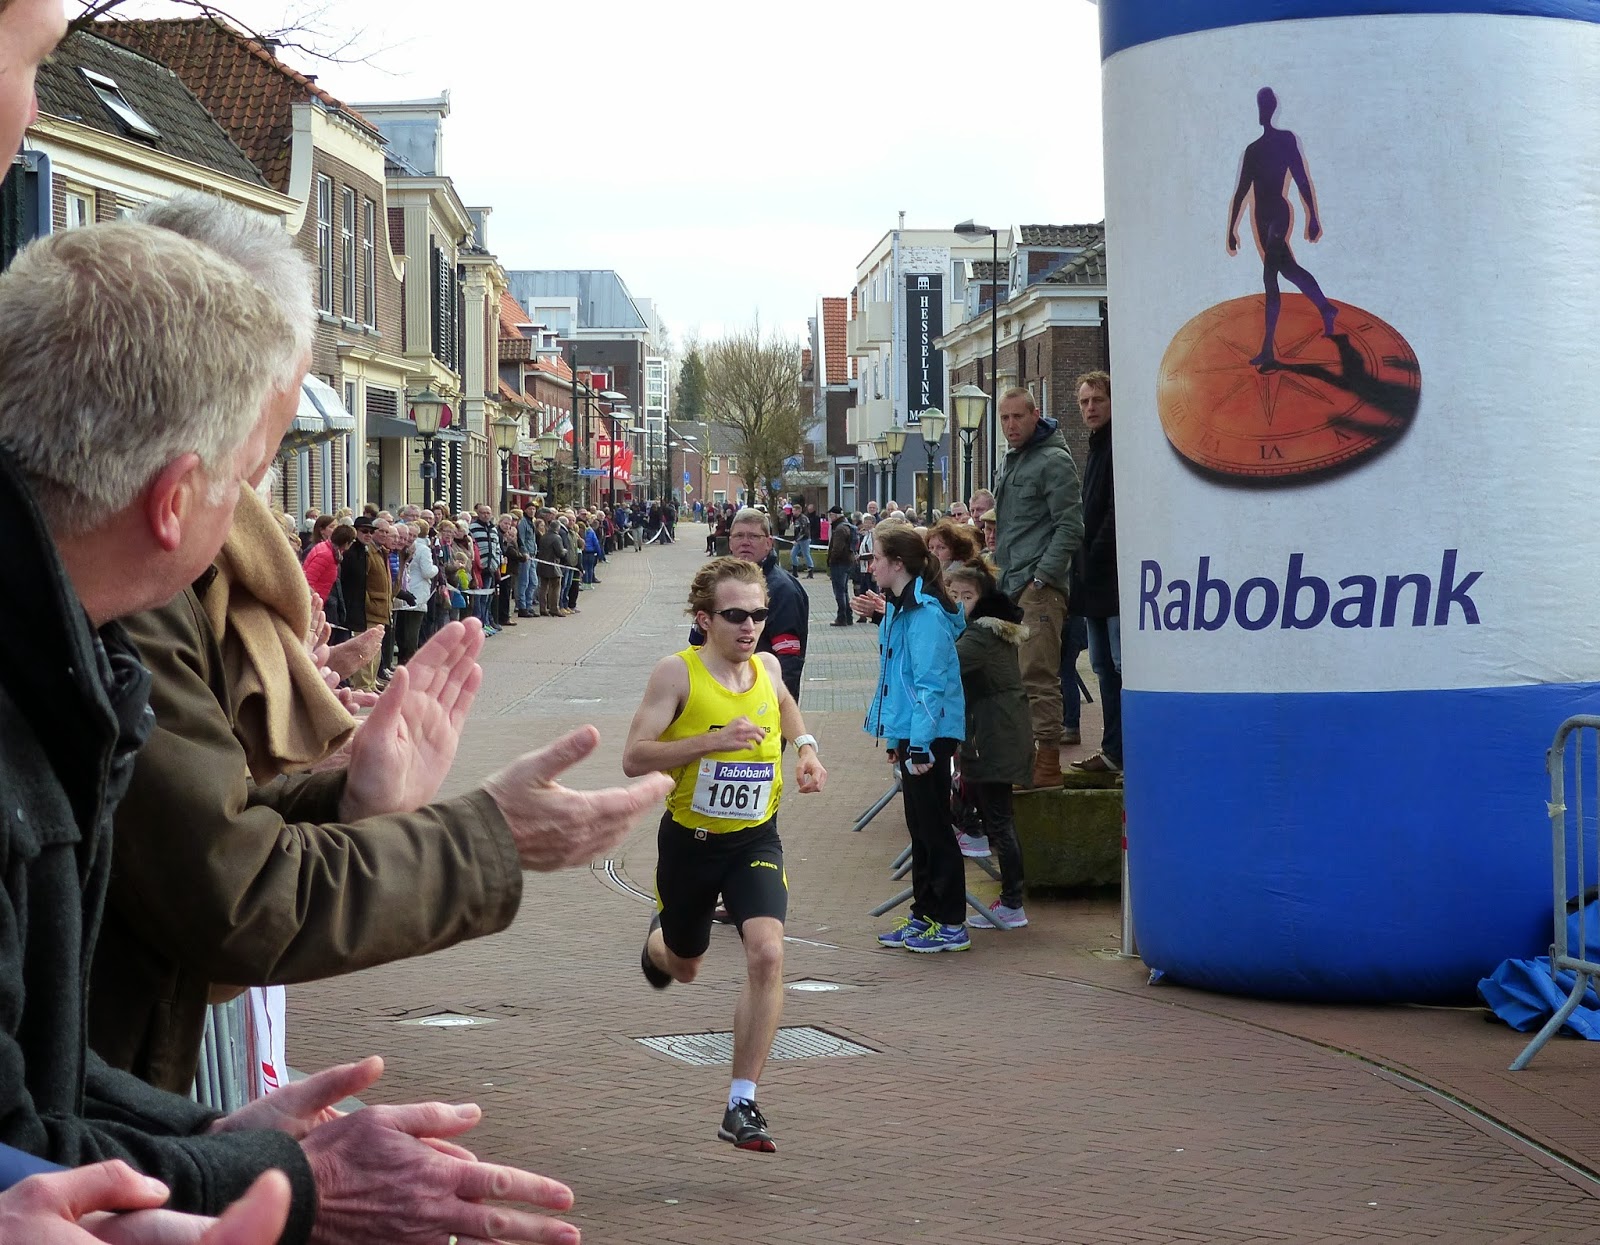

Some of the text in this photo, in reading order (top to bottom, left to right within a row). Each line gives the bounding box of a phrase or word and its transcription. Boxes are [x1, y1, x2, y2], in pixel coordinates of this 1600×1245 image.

[920, 296, 930, 405] HESSELINK
[1138, 549, 1484, 631] Rabobank
[708, 783, 762, 810] 1061
[719, 766, 771, 778] Rabobank
